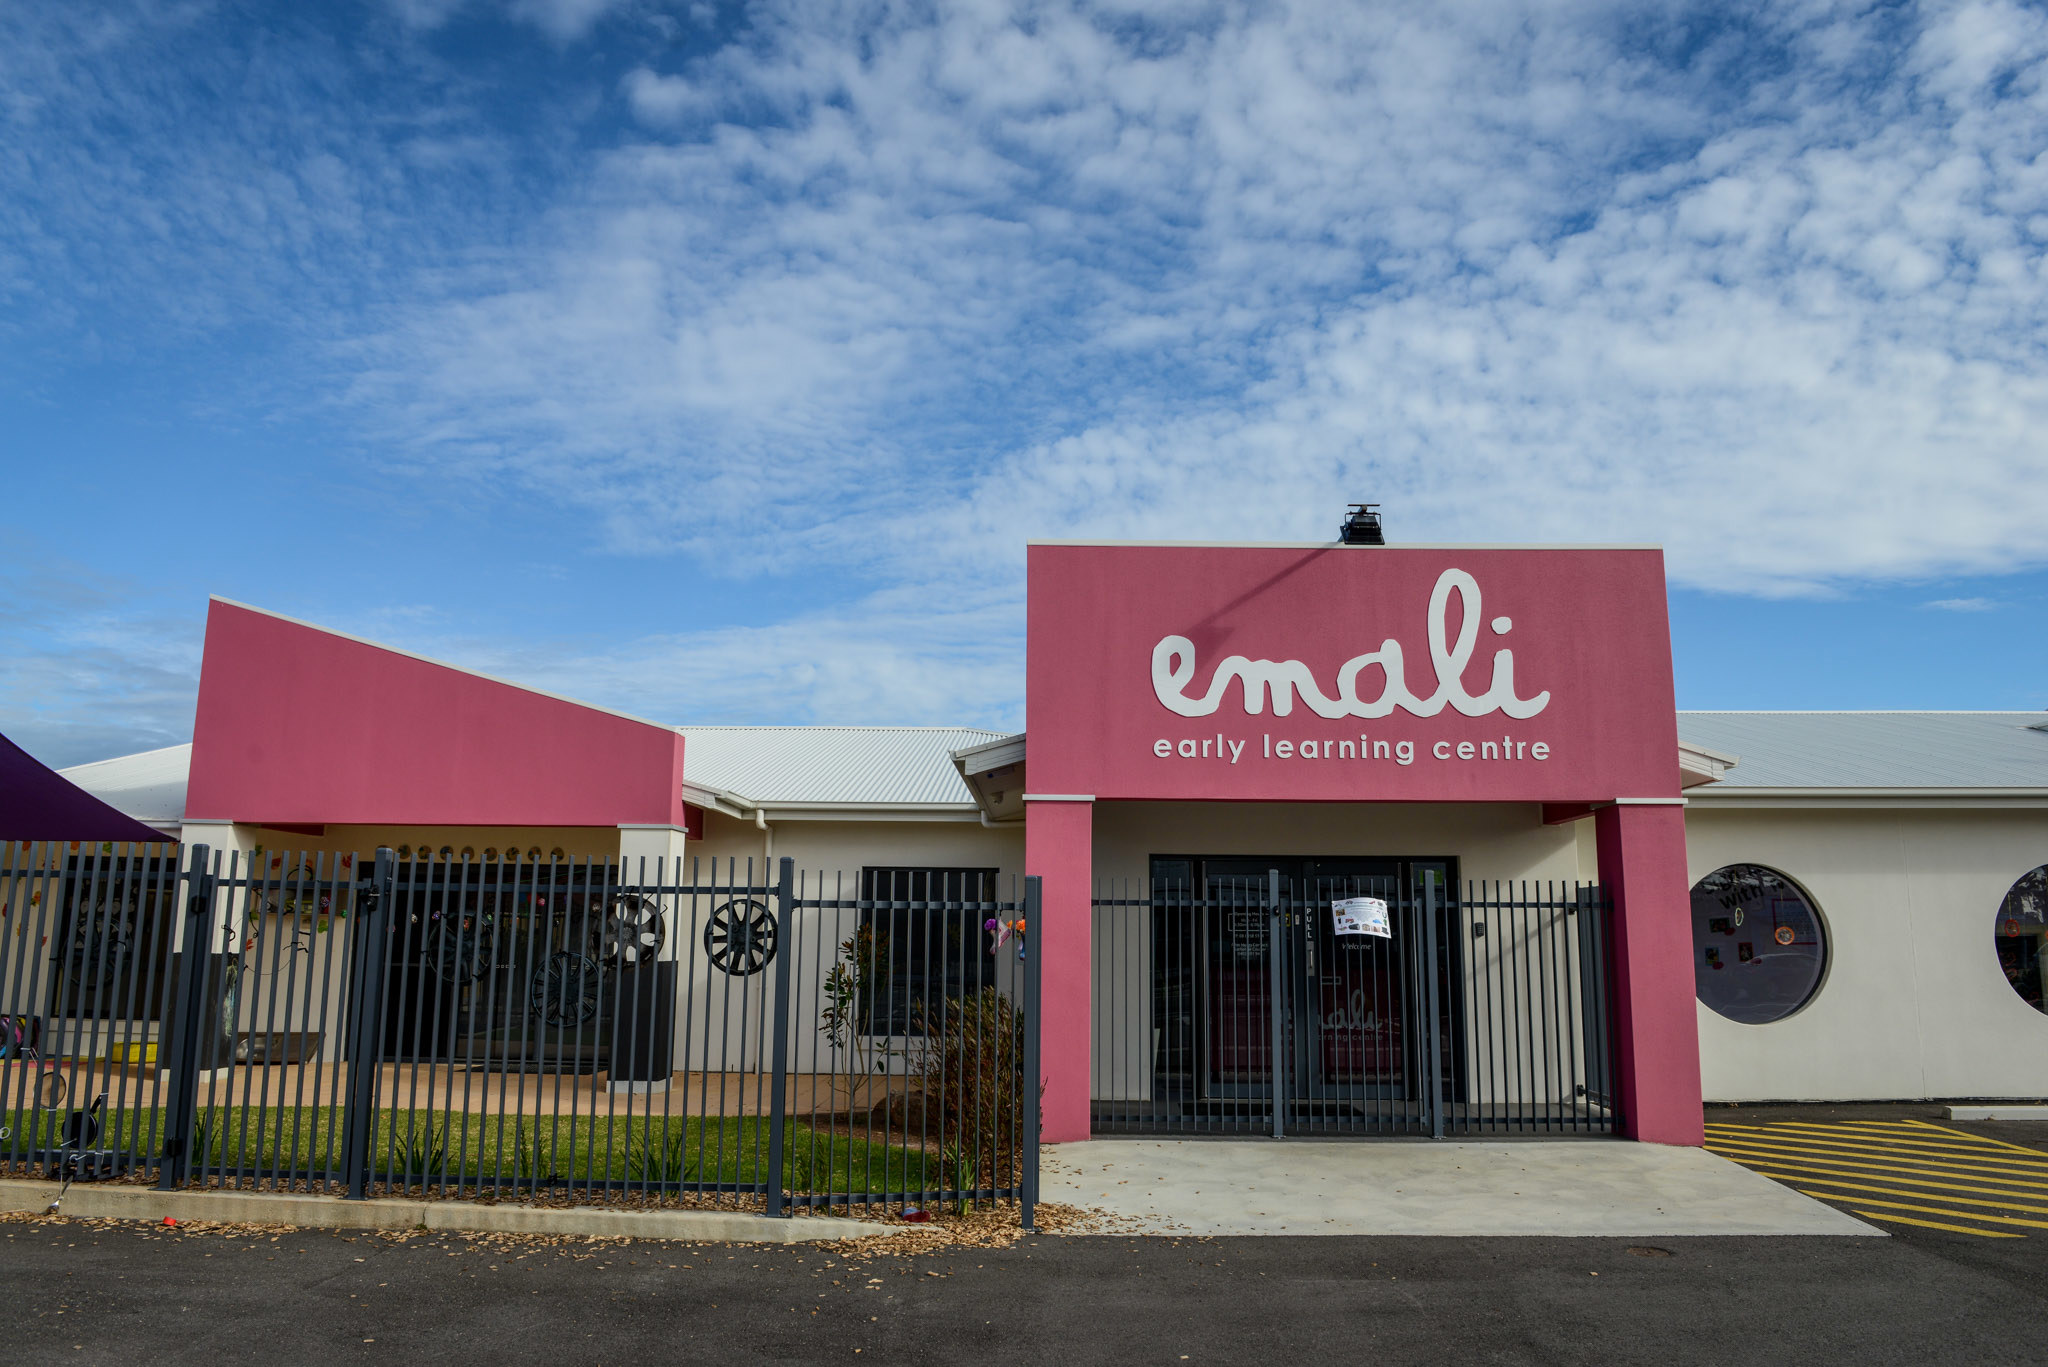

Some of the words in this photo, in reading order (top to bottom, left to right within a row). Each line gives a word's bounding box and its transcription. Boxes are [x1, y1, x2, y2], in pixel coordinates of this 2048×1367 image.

[1151, 567, 1551, 720] emali
[1153, 733, 1246, 764] early
[1263, 733, 1415, 766] learning
[1432, 735, 1551, 761] centre
